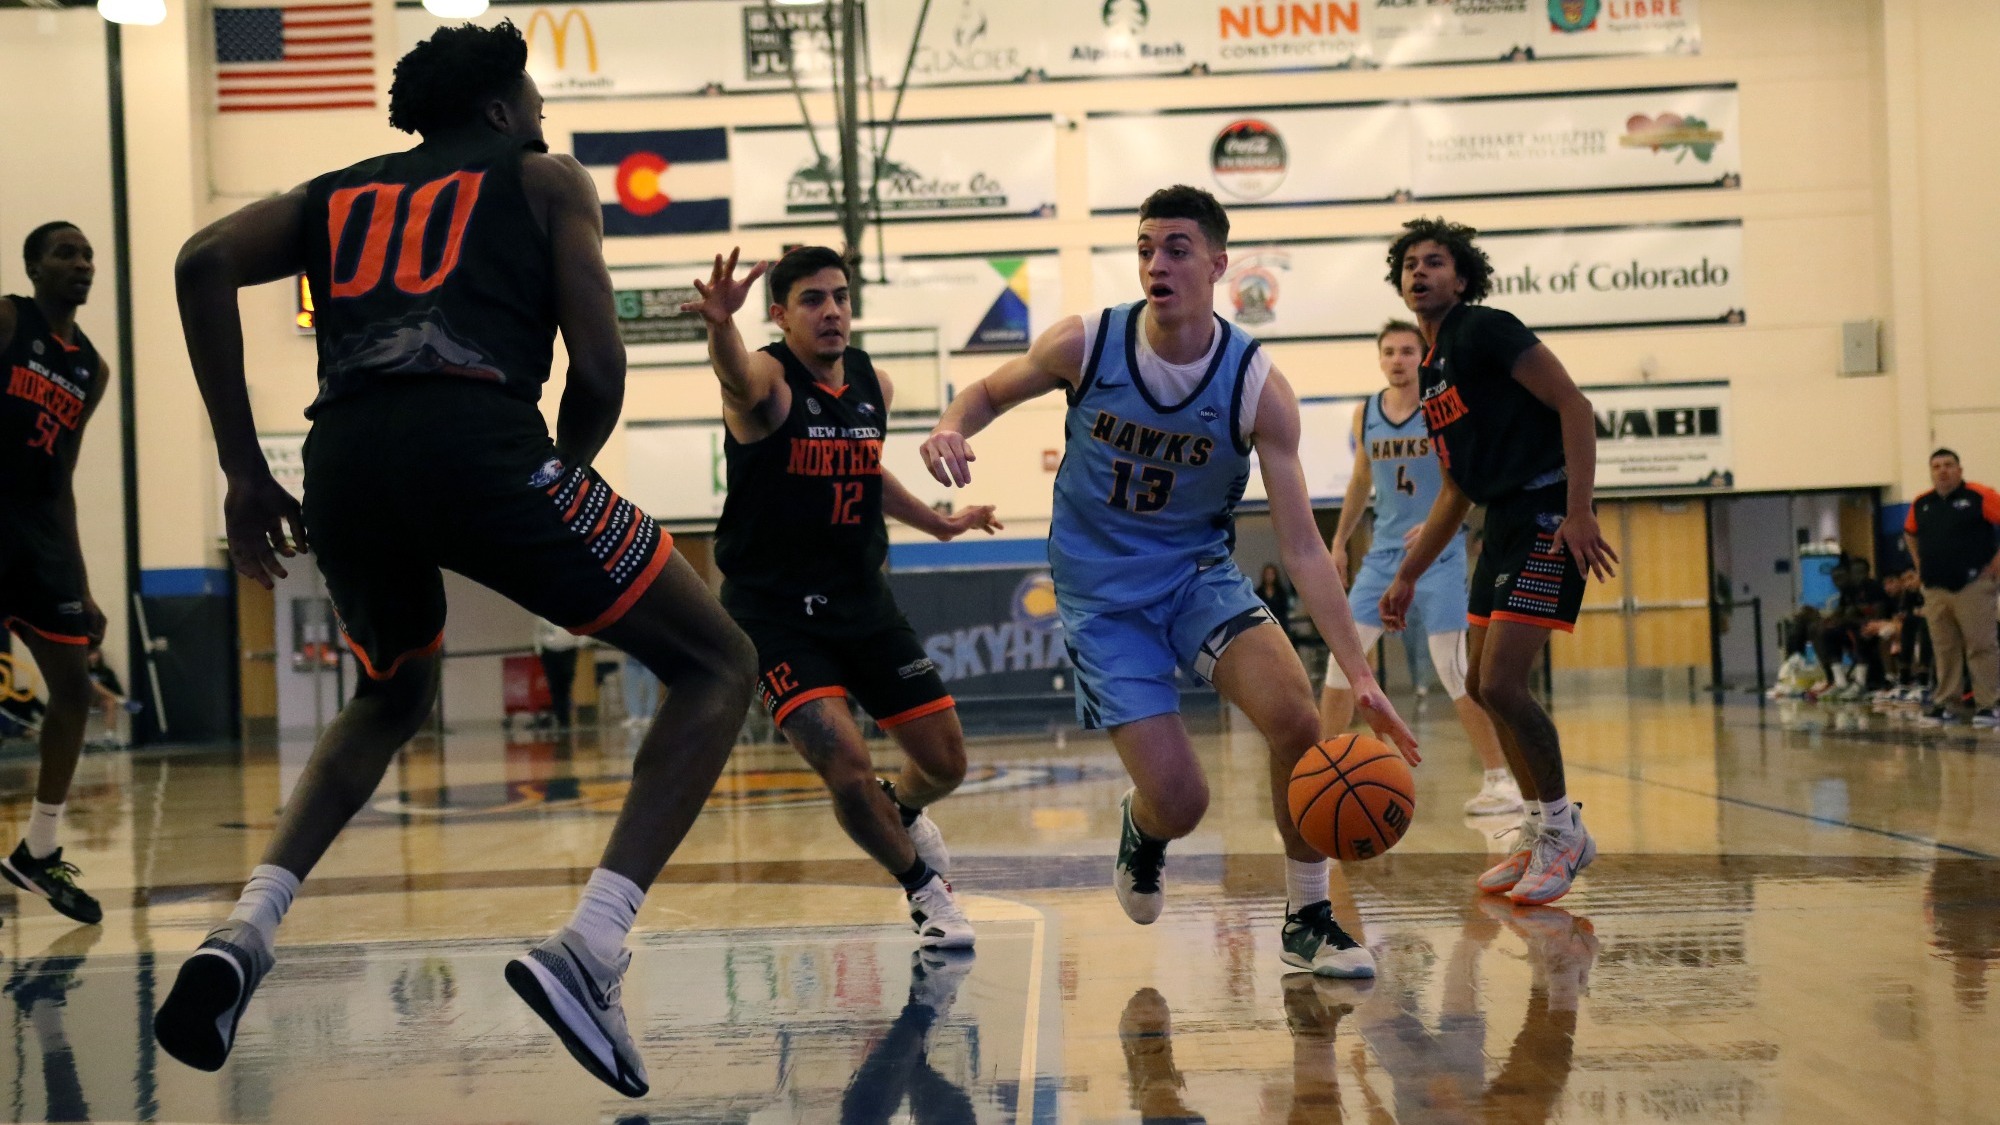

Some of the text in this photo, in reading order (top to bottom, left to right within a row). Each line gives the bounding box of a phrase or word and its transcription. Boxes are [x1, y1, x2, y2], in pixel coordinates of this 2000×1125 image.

[1219, 1, 1360, 39] NUNN
[327, 170, 488, 299] 00
[1550, 262, 1580, 294] of
[1587, 255, 1729, 293] Colorado
[807, 426, 836, 438] NEW
[1091, 410, 1214, 466] HAWKS
[1371, 438, 1430, 460] HAWKS
[1106, 458, 1176, 515] 13
[1395, 464, 1417, 497] 4
[831, 481, 864, 525] 12
[765, 661, 800, 698] 12
